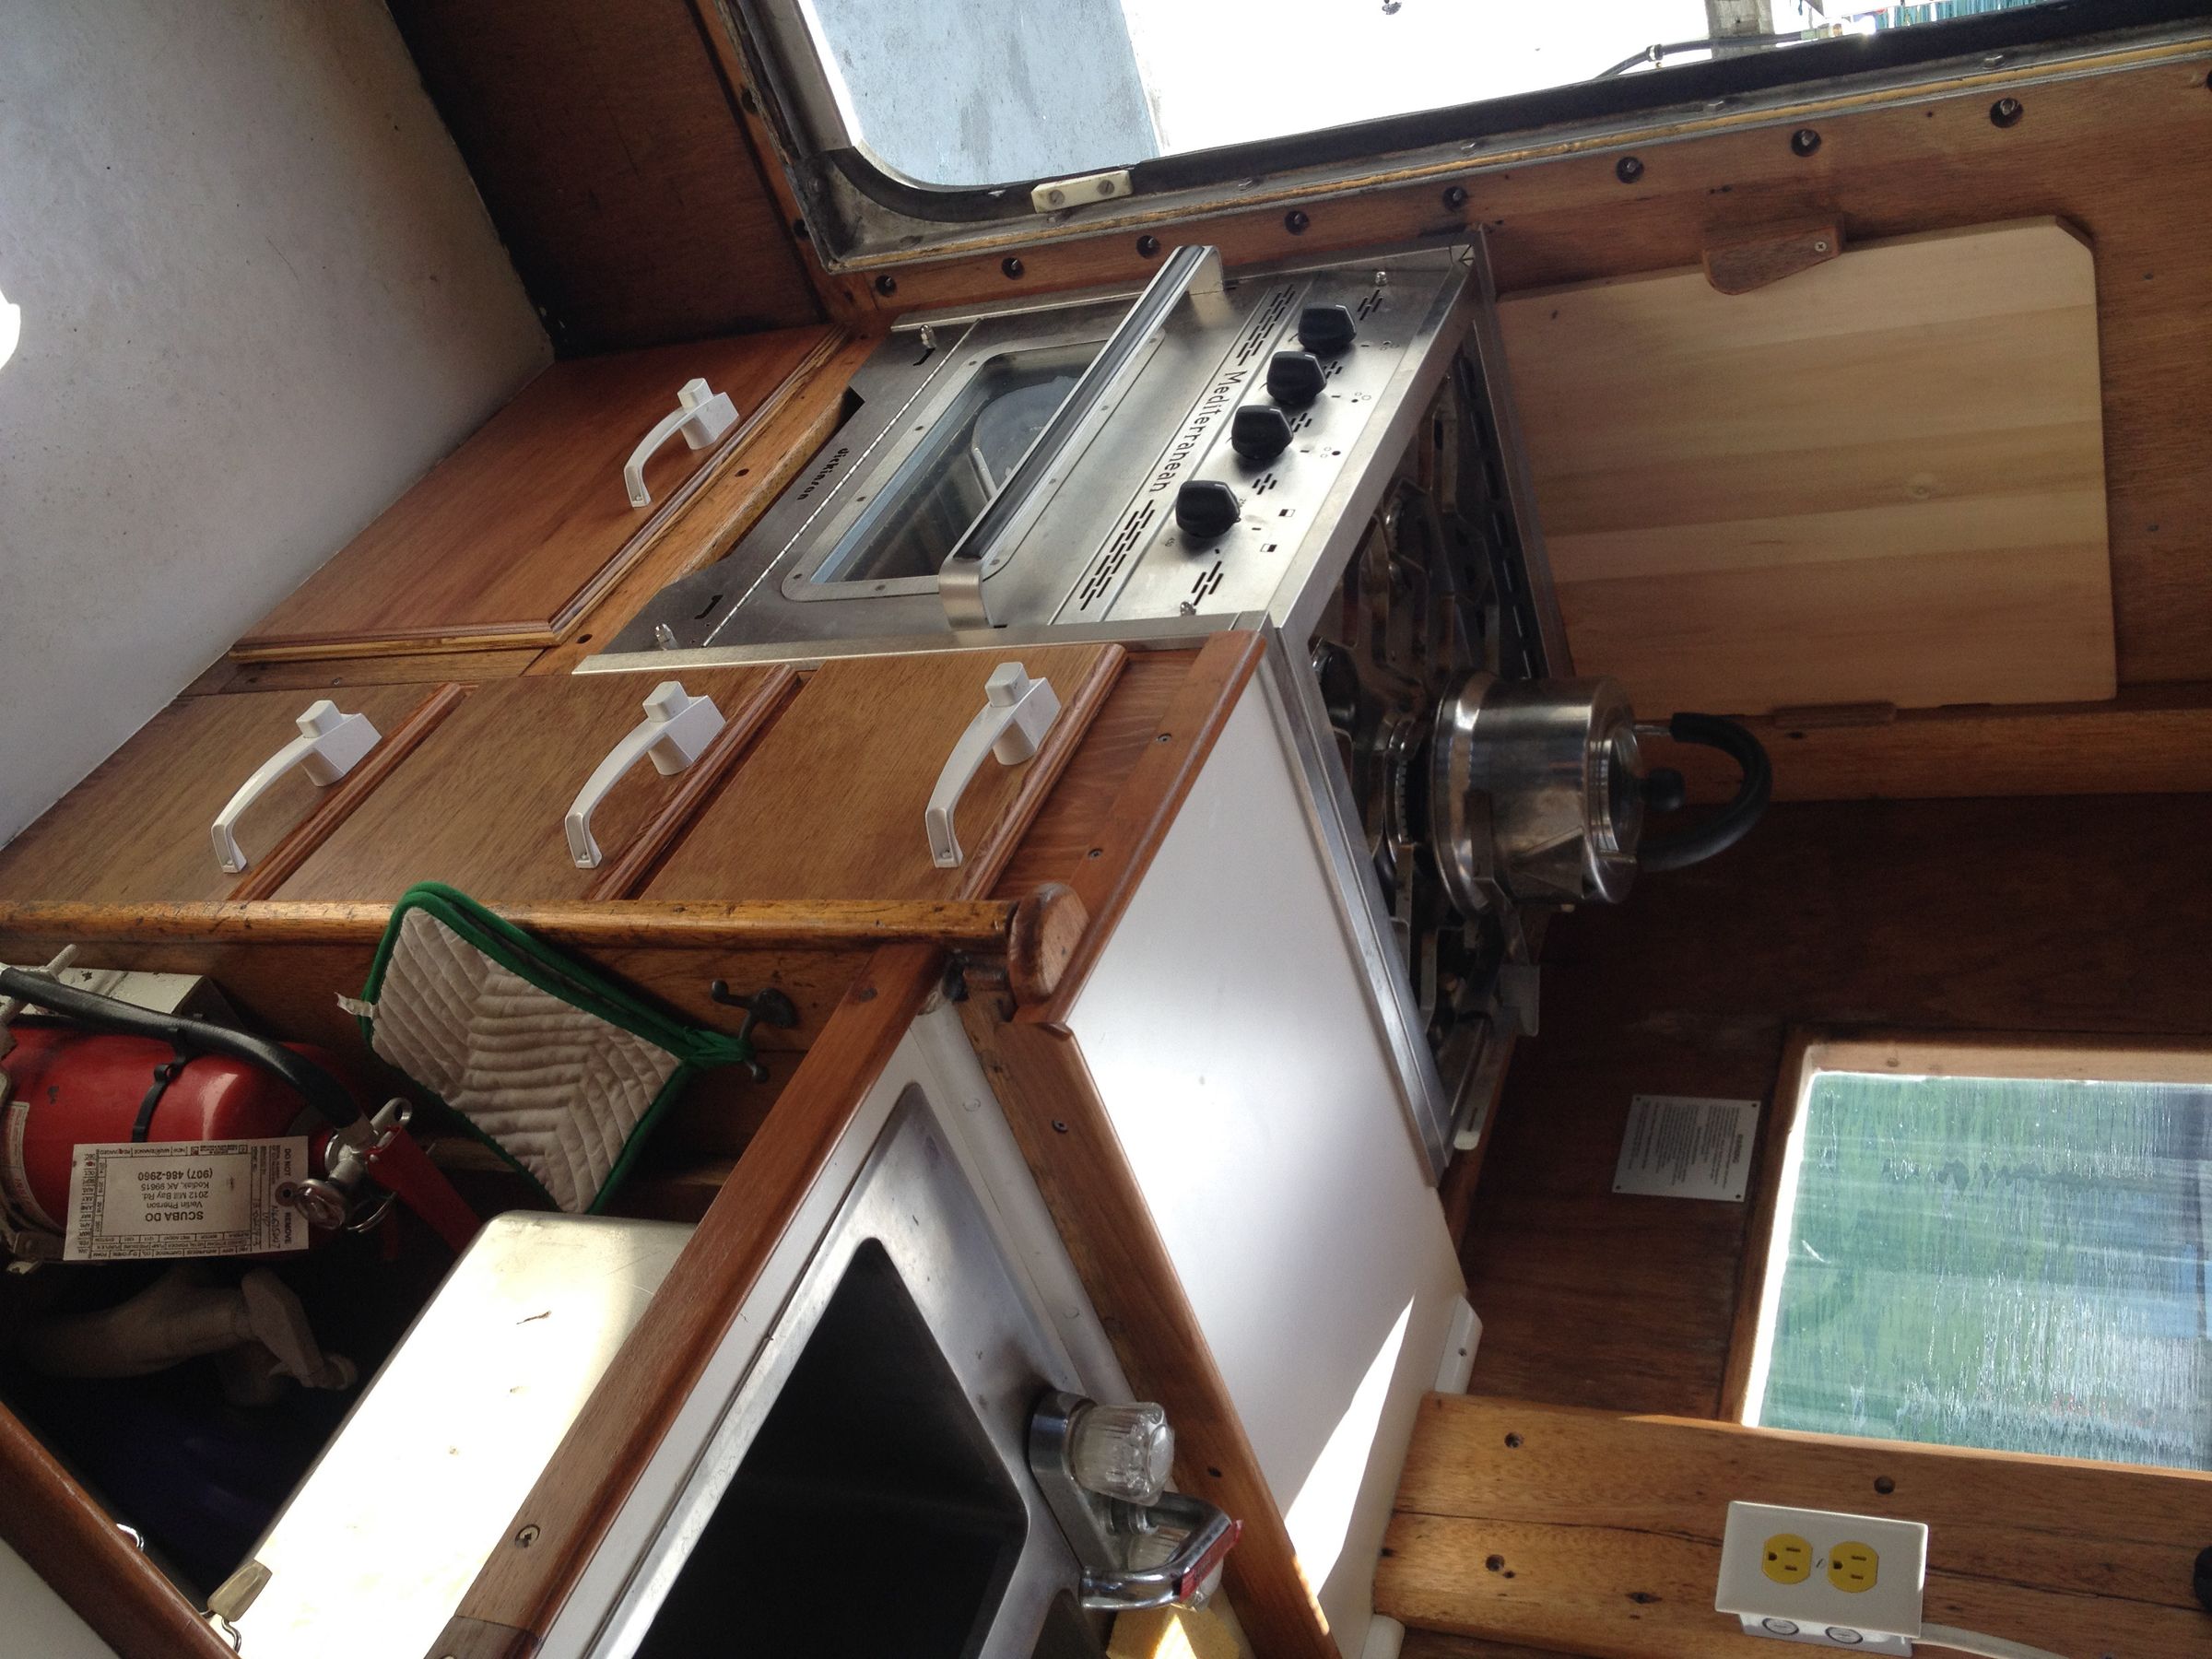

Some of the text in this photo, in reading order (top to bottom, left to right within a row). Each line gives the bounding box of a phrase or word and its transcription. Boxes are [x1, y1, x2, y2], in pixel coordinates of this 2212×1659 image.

[1149, 371, 1248, 493] Mediterranean
[186, 1168, 213, 1180] (907)
[157, 1191, 172, 1200] Bay
[284, 1148, 292, 1244] DO NOT REMOVE
[145, 1211, 204, 1222] SCUBA DO
